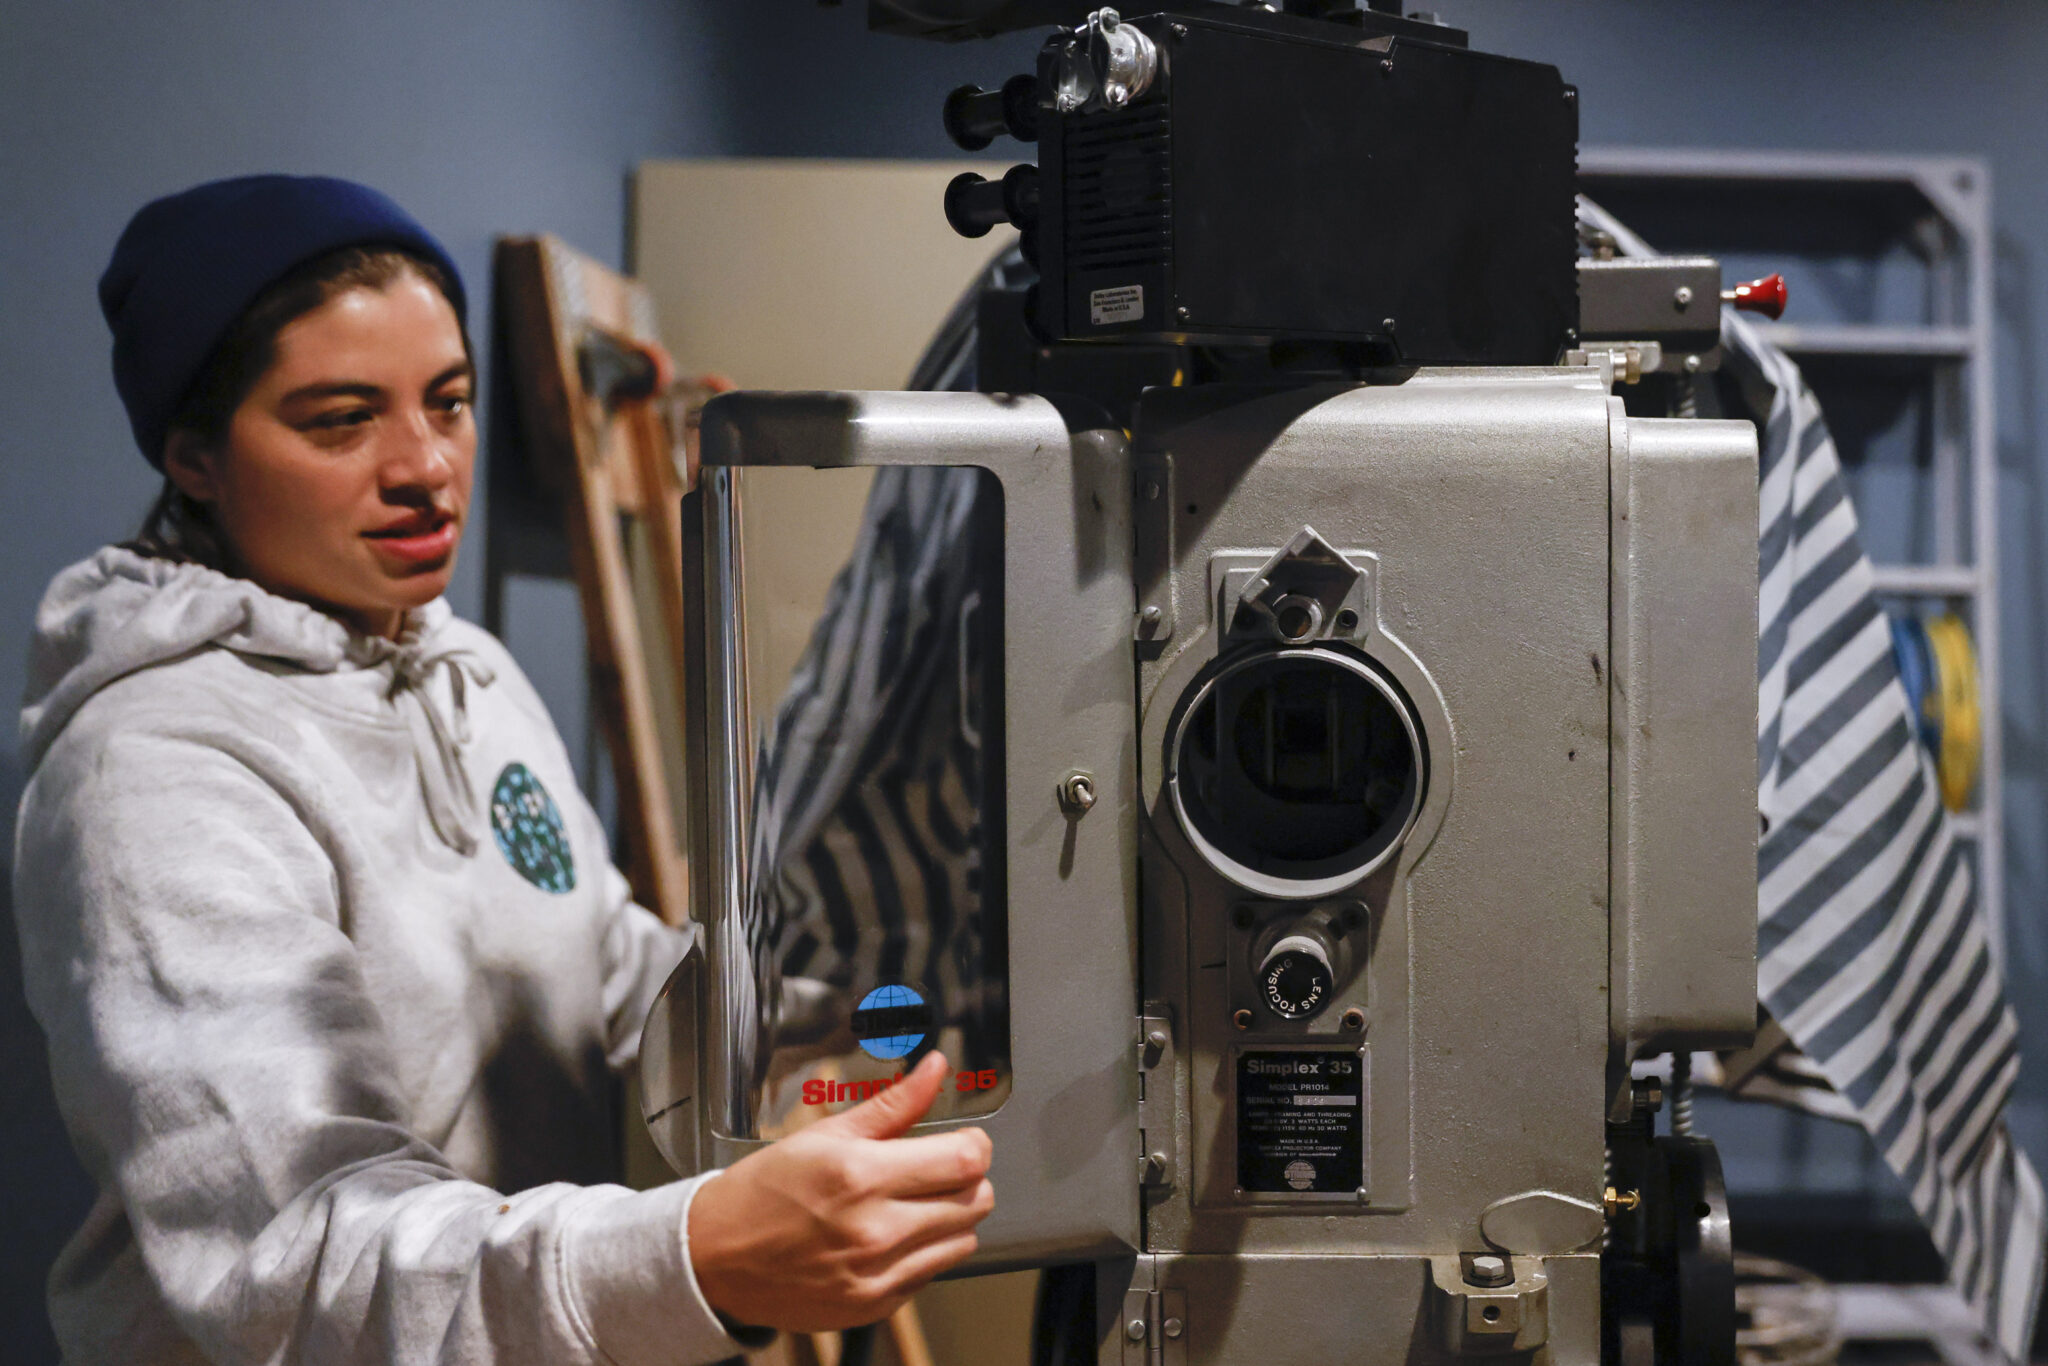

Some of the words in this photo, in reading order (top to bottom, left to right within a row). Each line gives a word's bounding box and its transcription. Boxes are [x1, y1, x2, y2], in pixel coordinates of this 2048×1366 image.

[1267, 958, 1296, 1013] FOCUSING
[1301, 976, 1322, 1010] LENS
[1330, 1060, 1352, 1074] 35
[956, 1069, 997, 1092] 35
[1300, 1083, 1330, 1091] PR1014
